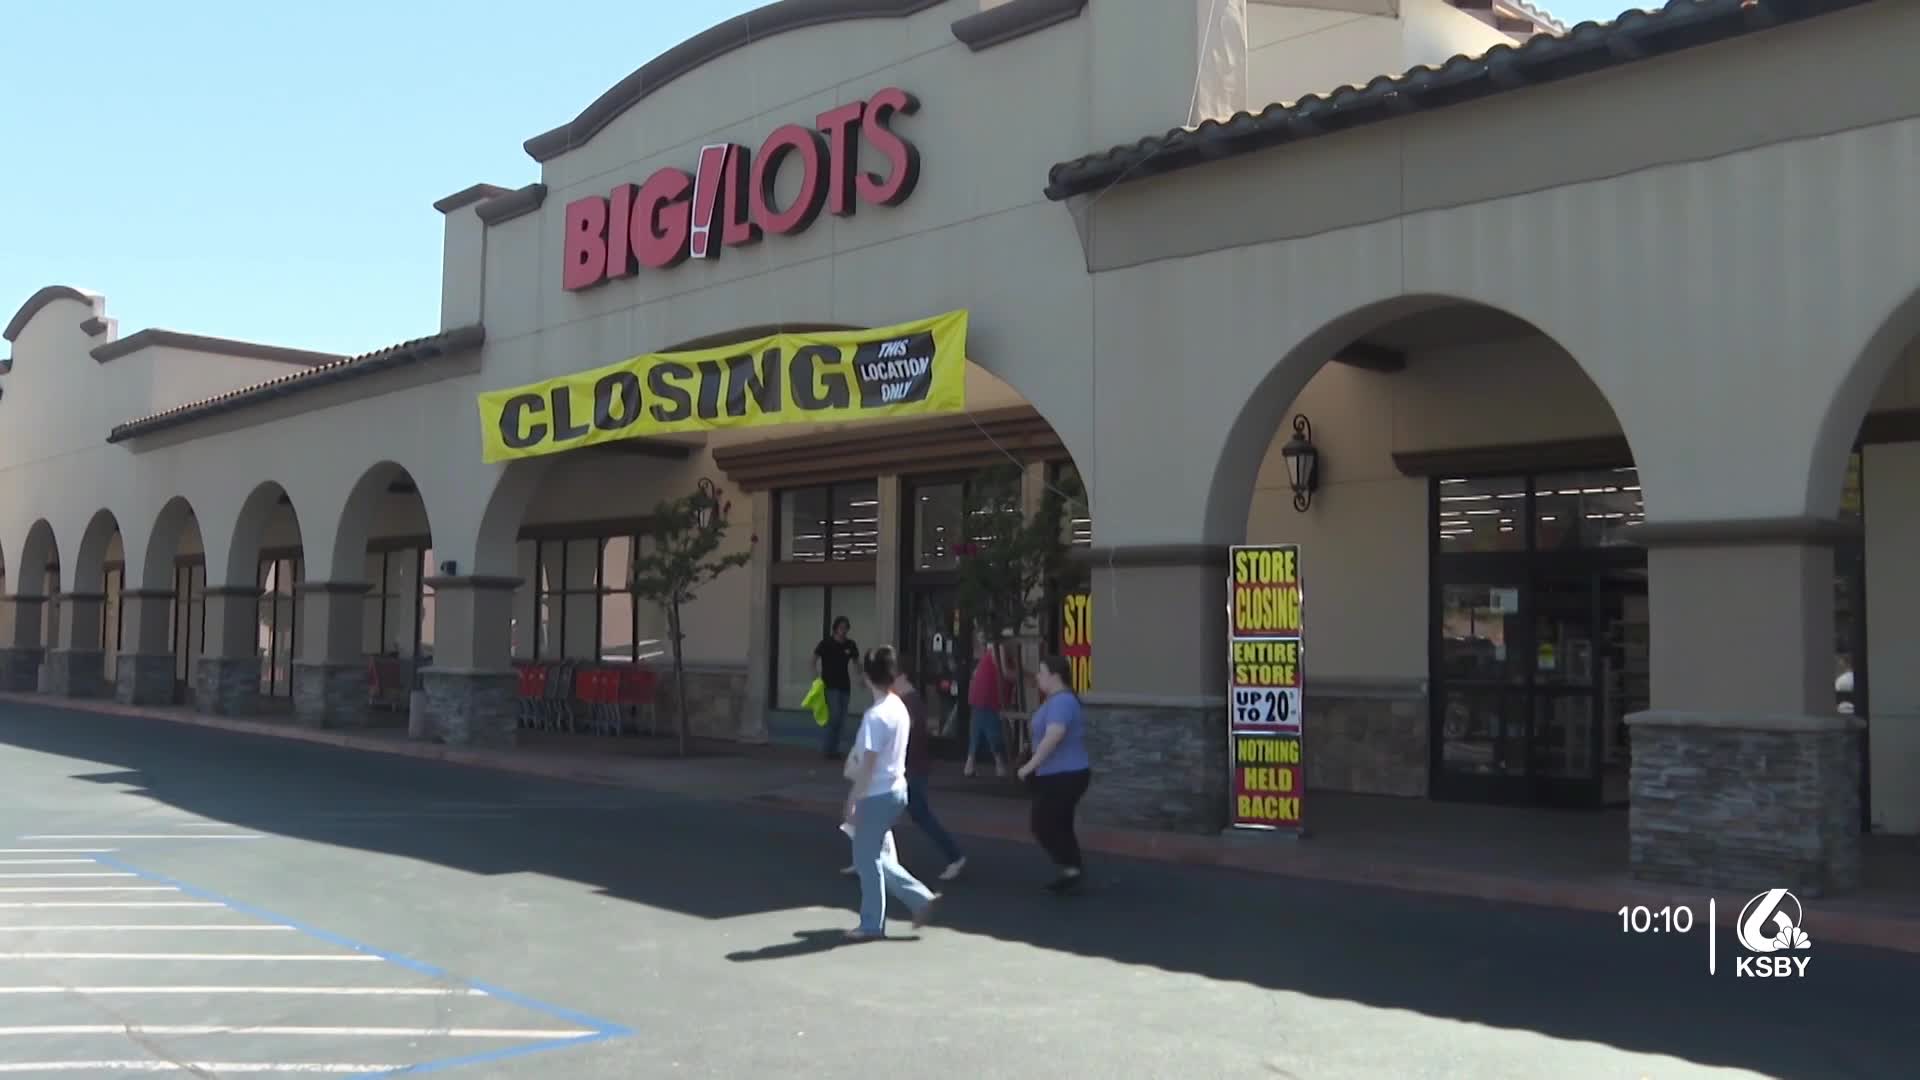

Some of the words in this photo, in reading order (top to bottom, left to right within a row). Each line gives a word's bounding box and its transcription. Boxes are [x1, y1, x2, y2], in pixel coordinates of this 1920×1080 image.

[878, 339, 908, 357] THIS
[860, 356, 929, 381] LOCATION
[499, 344, 850, 449] CLOSING
[881, 381, 912, 402] ONLY
[1235, 551, 1295, 584] STORE
[1235, 586, 1298, 630] CLOSING
[1234, 642, 1296, 663] ENTIRE
[1236, 665, 1295, 685] STORE
[1236, 692, 1261, 706] UP
[1237, 707, 1260, 721] TO
[1238, 739, 1299, 764] NOTHING
[1244, 767, 1292, 791] HELD
[1238, 796, 1299, 820] BACK!
